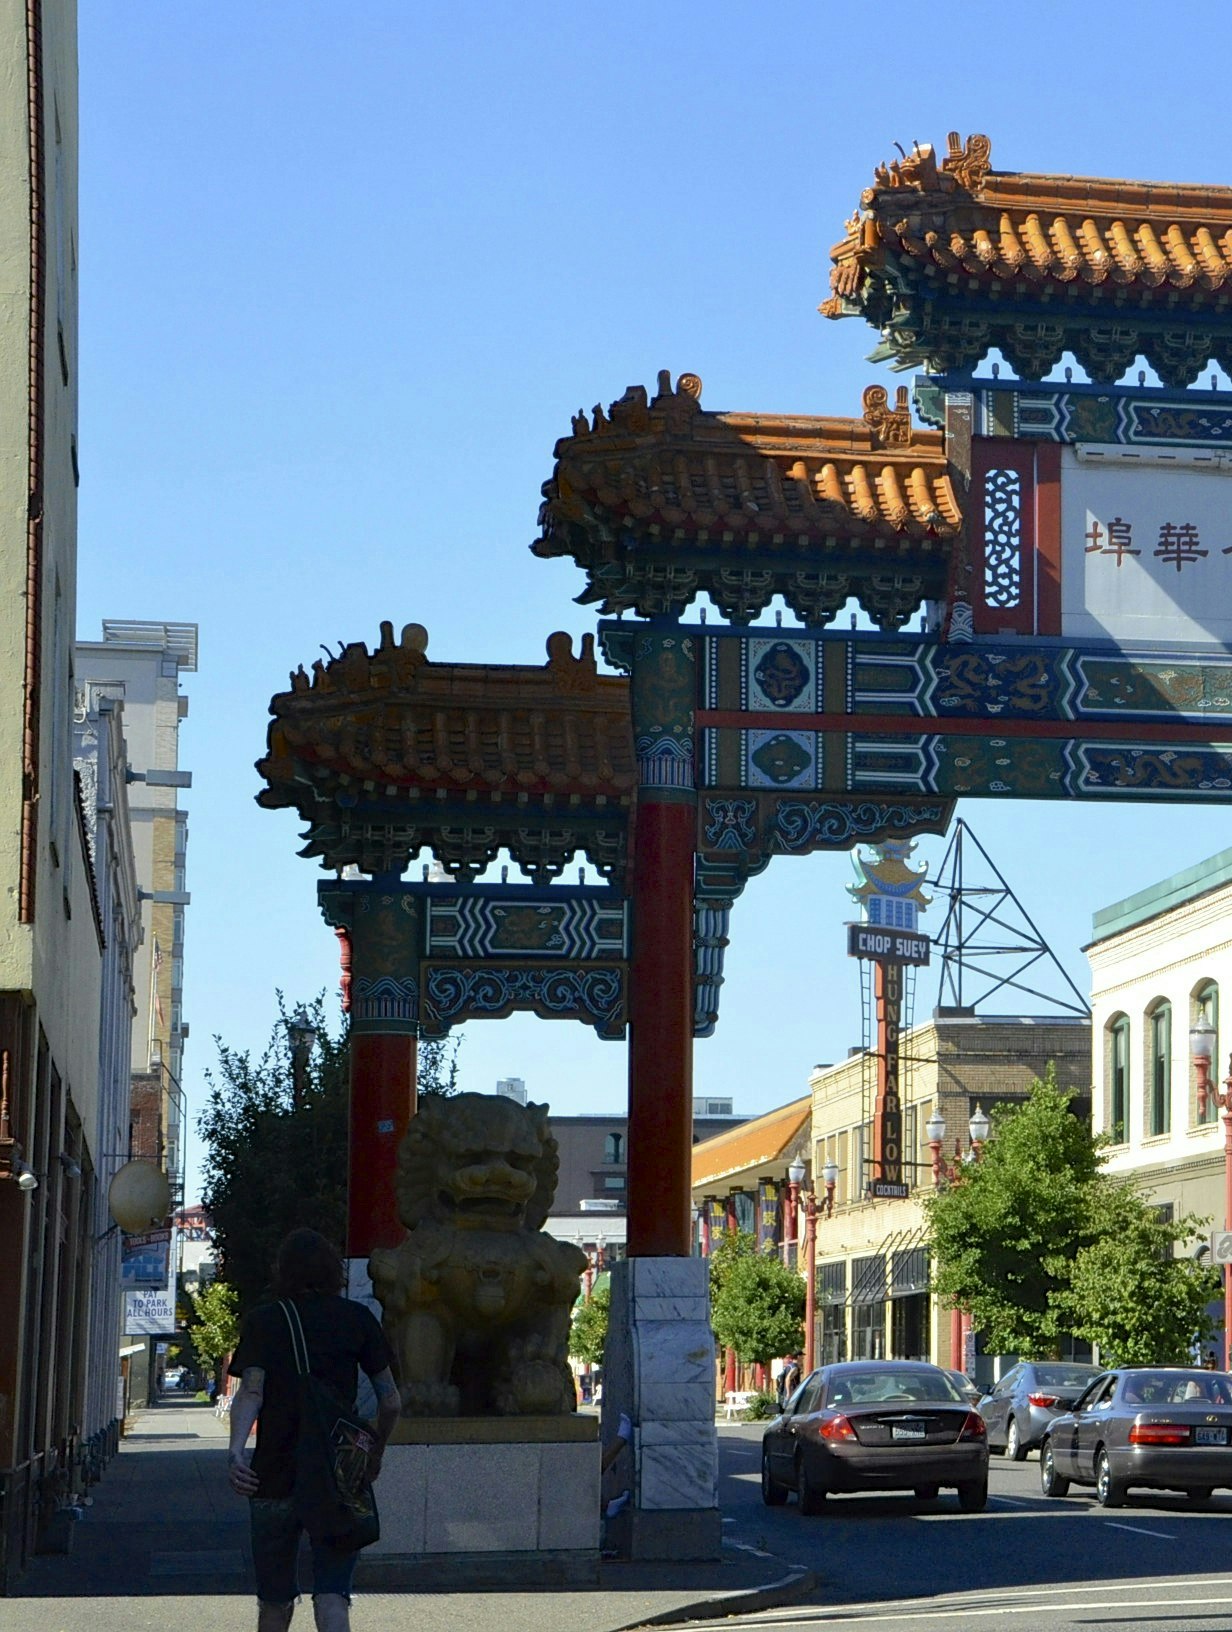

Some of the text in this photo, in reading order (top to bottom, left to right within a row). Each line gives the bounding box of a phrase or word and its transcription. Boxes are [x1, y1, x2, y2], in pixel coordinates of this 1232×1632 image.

[858, 933, 926, 959] CHOP SUEY
[886, 964, 898, 1042] HUNG
[885, 1054, 898, 1113] FAR
[885, 1121, 899, 1181] LOW
[876, 1184, 907, 1197] COCKTAILS
[133, 1298, 167, 1308] TO PARK
[143, 1290, 158, 1299] PAY
[127, 1307, 173, 1317] ALL HOURS
